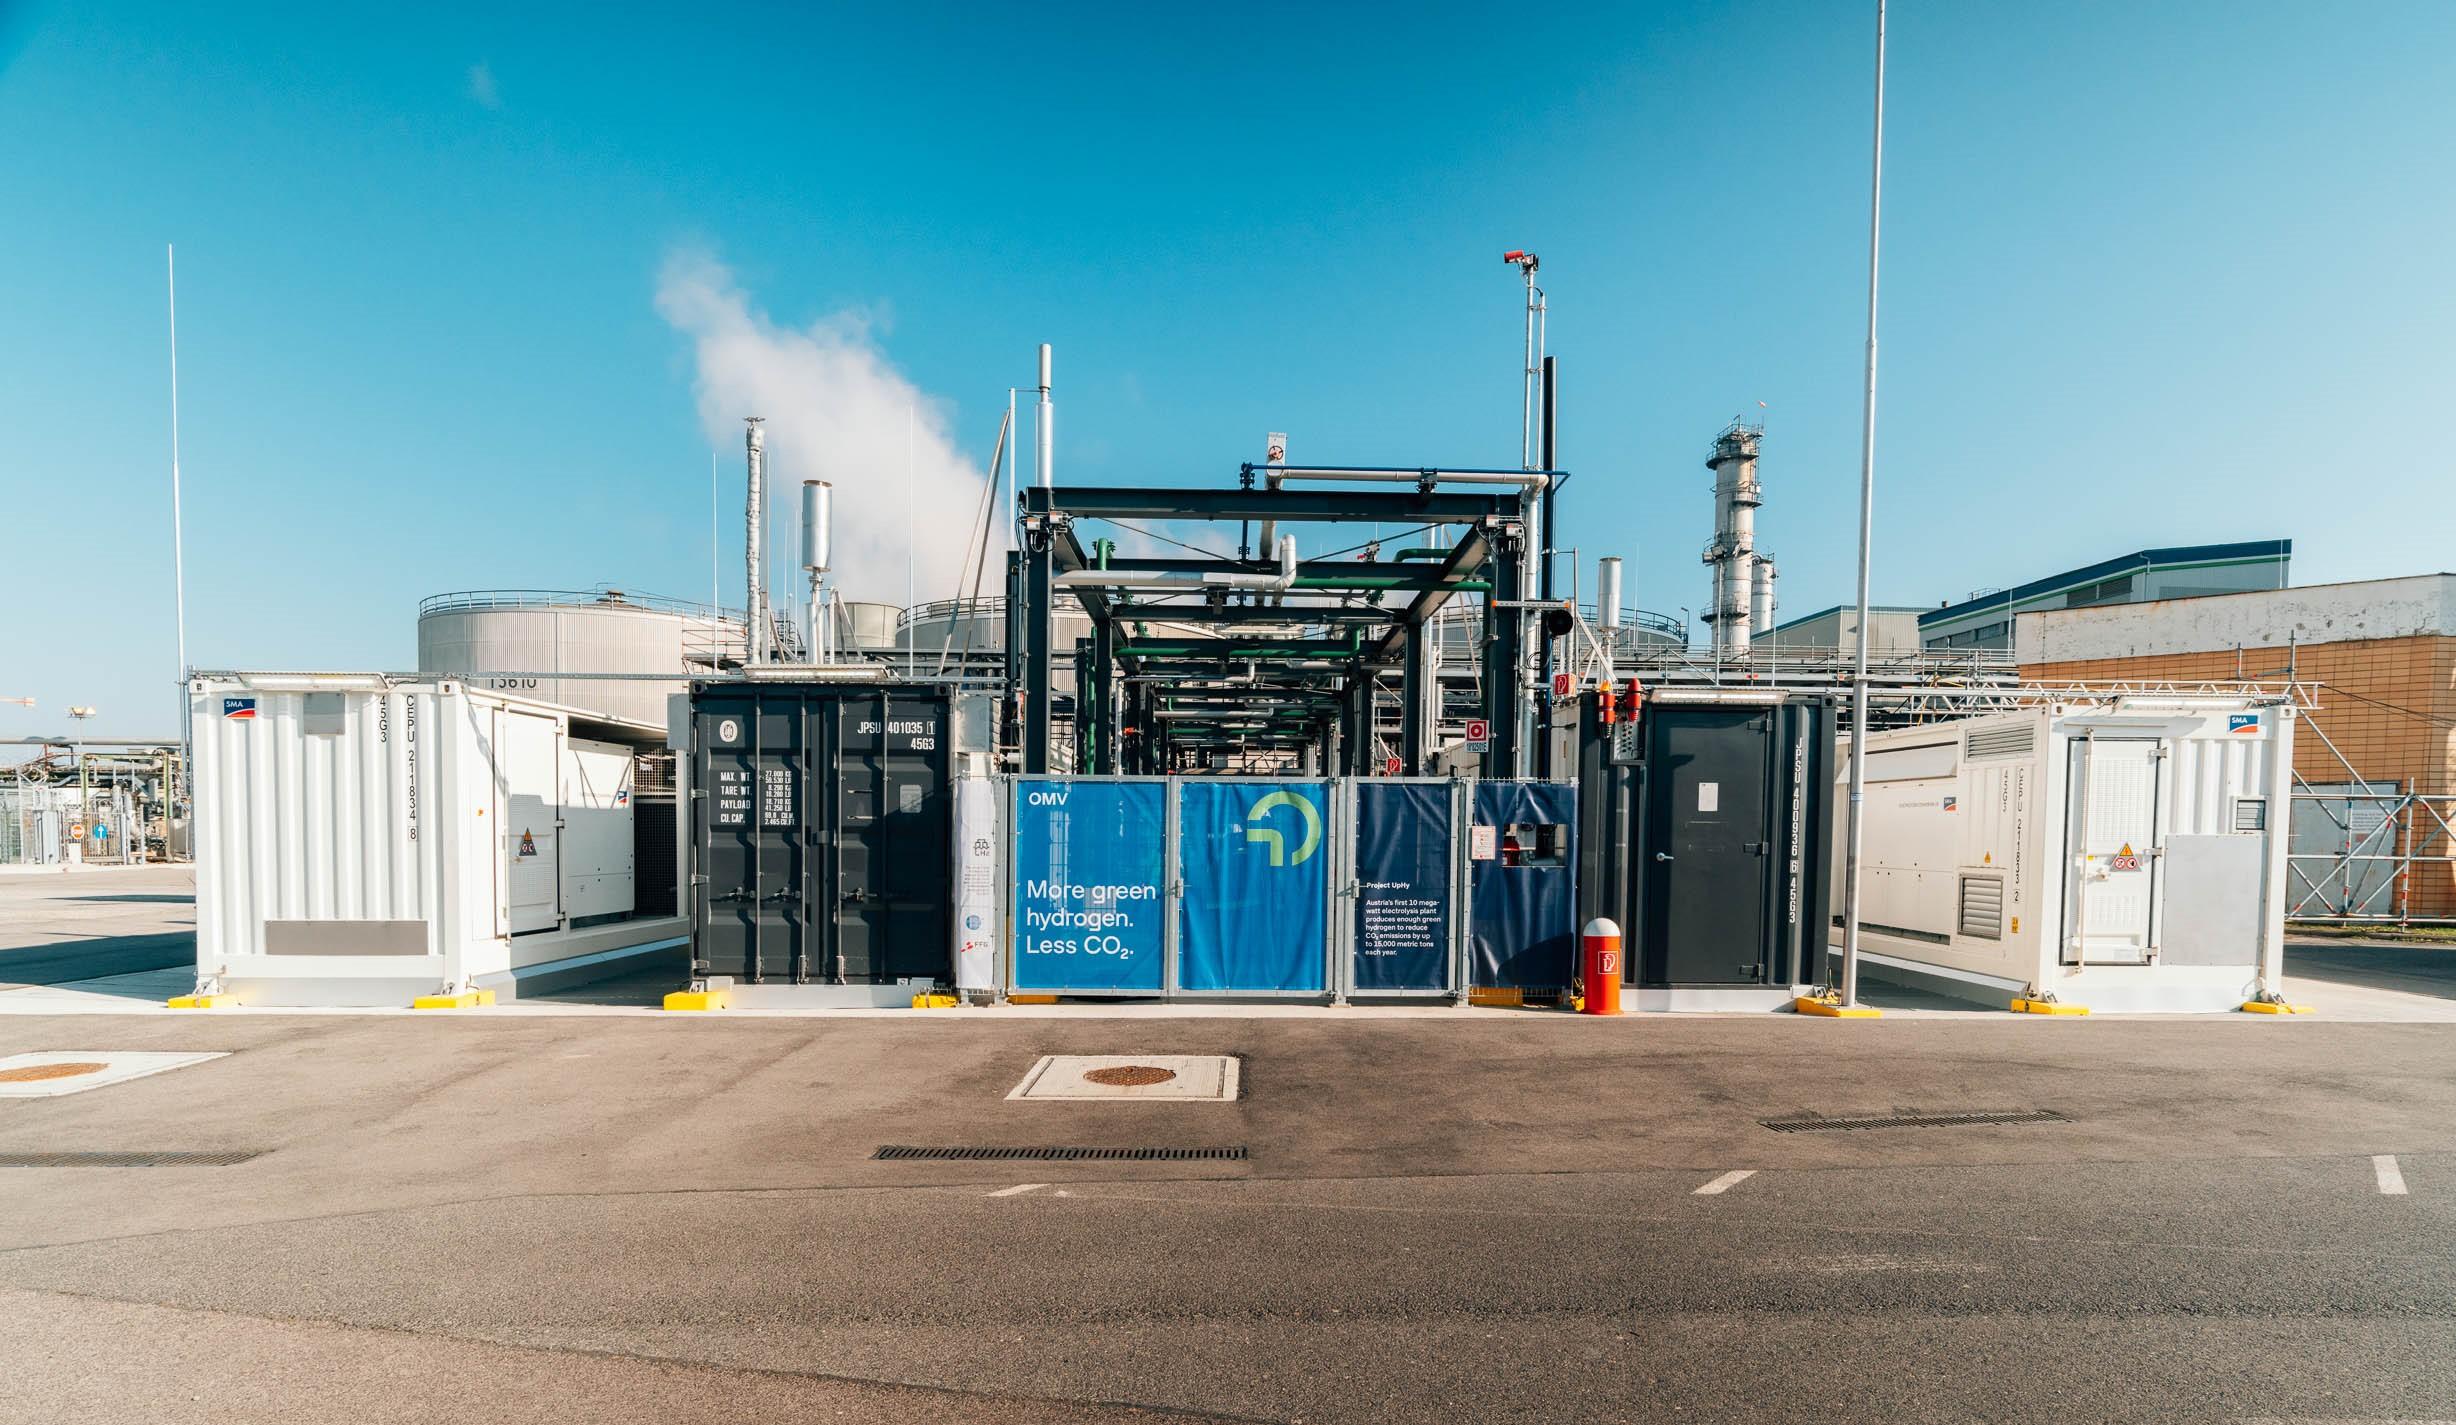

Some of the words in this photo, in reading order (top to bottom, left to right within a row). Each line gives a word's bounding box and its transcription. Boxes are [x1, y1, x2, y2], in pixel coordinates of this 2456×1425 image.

[407, 695, 415, 742] CEPU
[857, 721, 881, 734] JPSU
[888, 721, 923, 734] 401035
[408, 750, 416, 820] 211834
[720, 786, 738, 795] TARE
[720, 800, 751, 809] PAYLOAD
[1028, 792, 1069, 805] OMV
[1027, 880, 1085, 899] More
[1091, 885, 1156, 904] green
[1027, 907, 1134, 931] hydrogen.
[1026, 935, 1077, 954] Less
